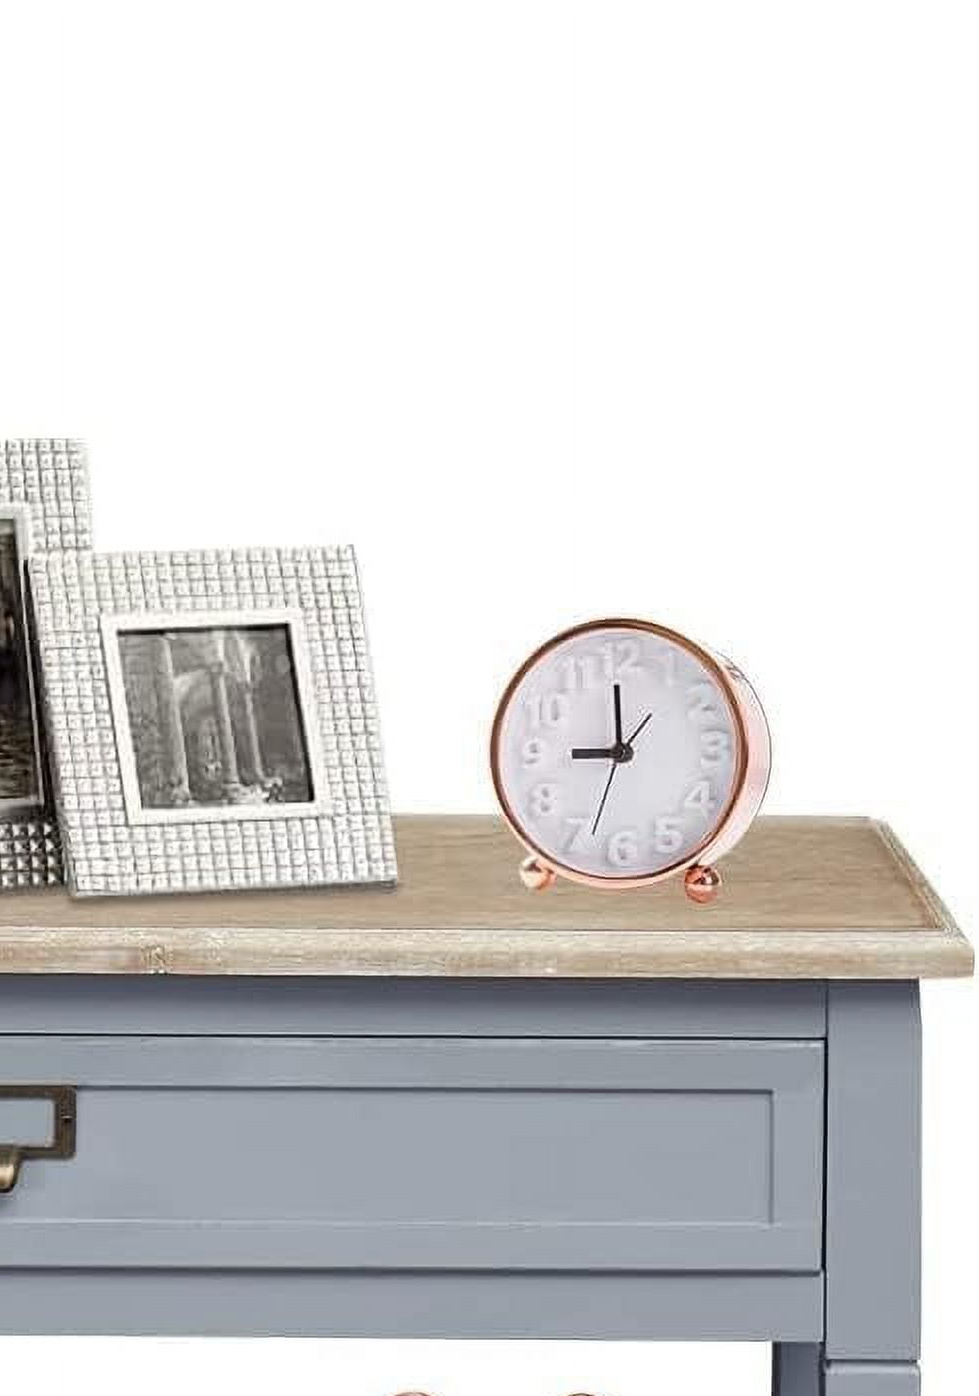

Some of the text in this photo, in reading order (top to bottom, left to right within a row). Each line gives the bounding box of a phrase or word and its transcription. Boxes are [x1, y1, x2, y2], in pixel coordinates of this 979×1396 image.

[604, 639, 640, 674] 12
[525, 692, 568, 728] 10
[523, 738, 546, 768] 9
[532, 782, 558, 816] 8
[685, 780, 717, 819] 4
[564, 816, 588, 851] 7
[608, 831, 638, 865] 6
[654, 816, 685, 854] 5
